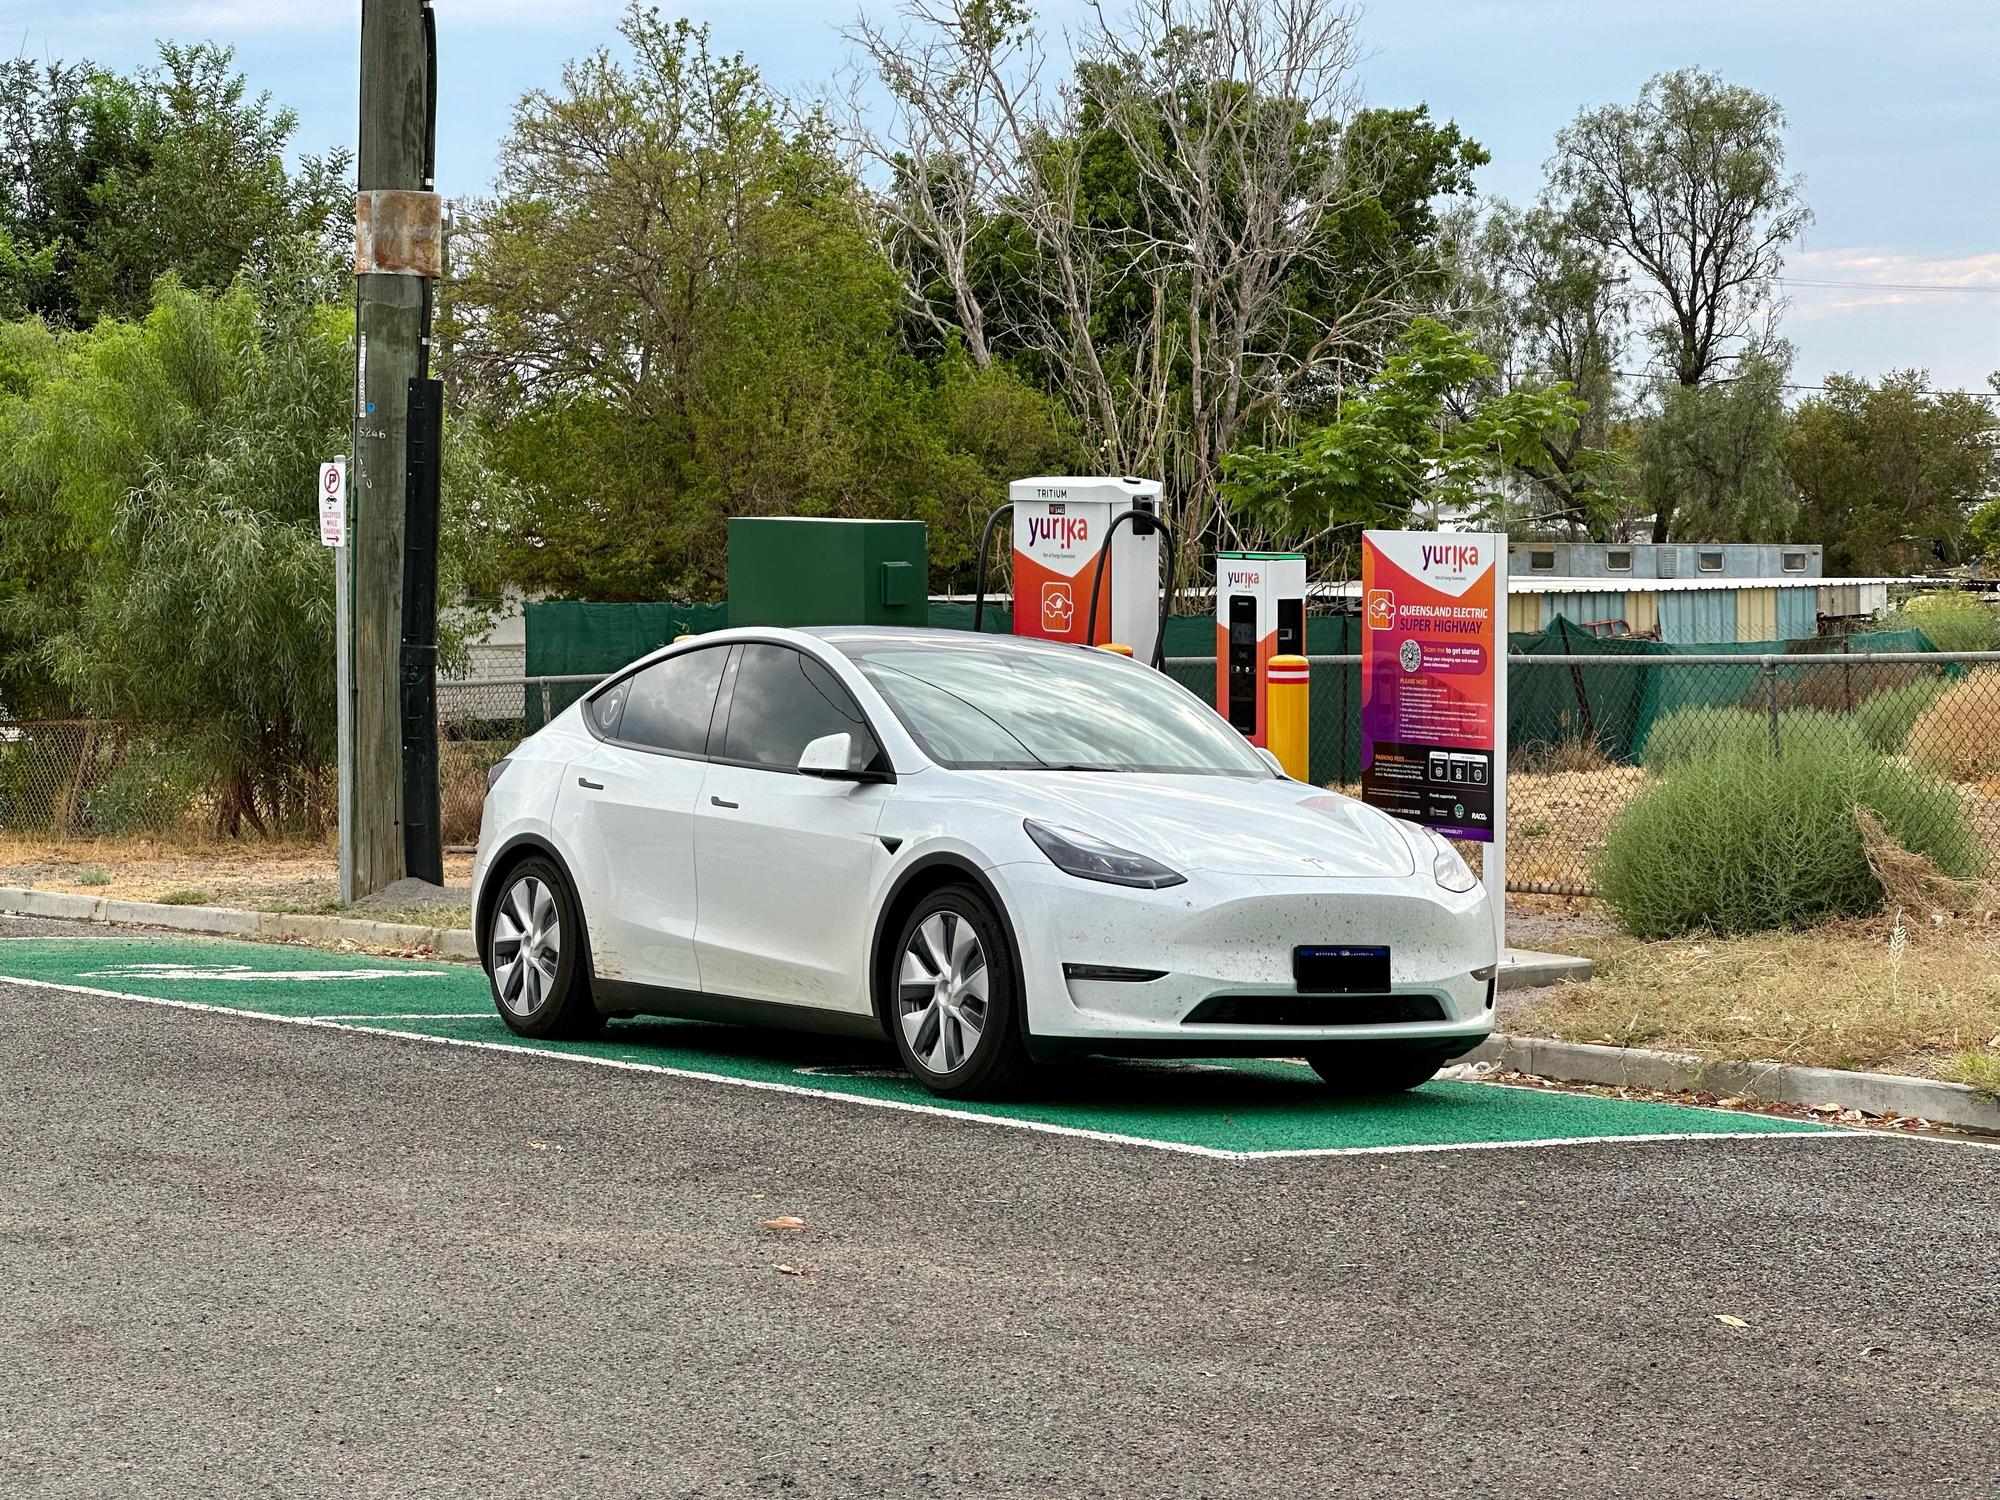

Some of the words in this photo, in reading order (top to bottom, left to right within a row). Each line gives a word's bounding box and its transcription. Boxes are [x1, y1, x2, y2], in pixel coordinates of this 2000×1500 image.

[1037, 489, 1067, 498] TRITIUM
[1028, 516, 1088, 549] yurika
[1422, 544, 1479, 573] yurika
[1228, 572, 1259, 588] yurika
[1400, 605, 1451, 616] QUEENSLAND
[1453, 608, 1488, 619] ELECTRIC
[1400, 619, 1430, 632] SUPER
[1434, 620, 1483, 634] HIGHWAY
[1452, 648, 1461, 656] get
